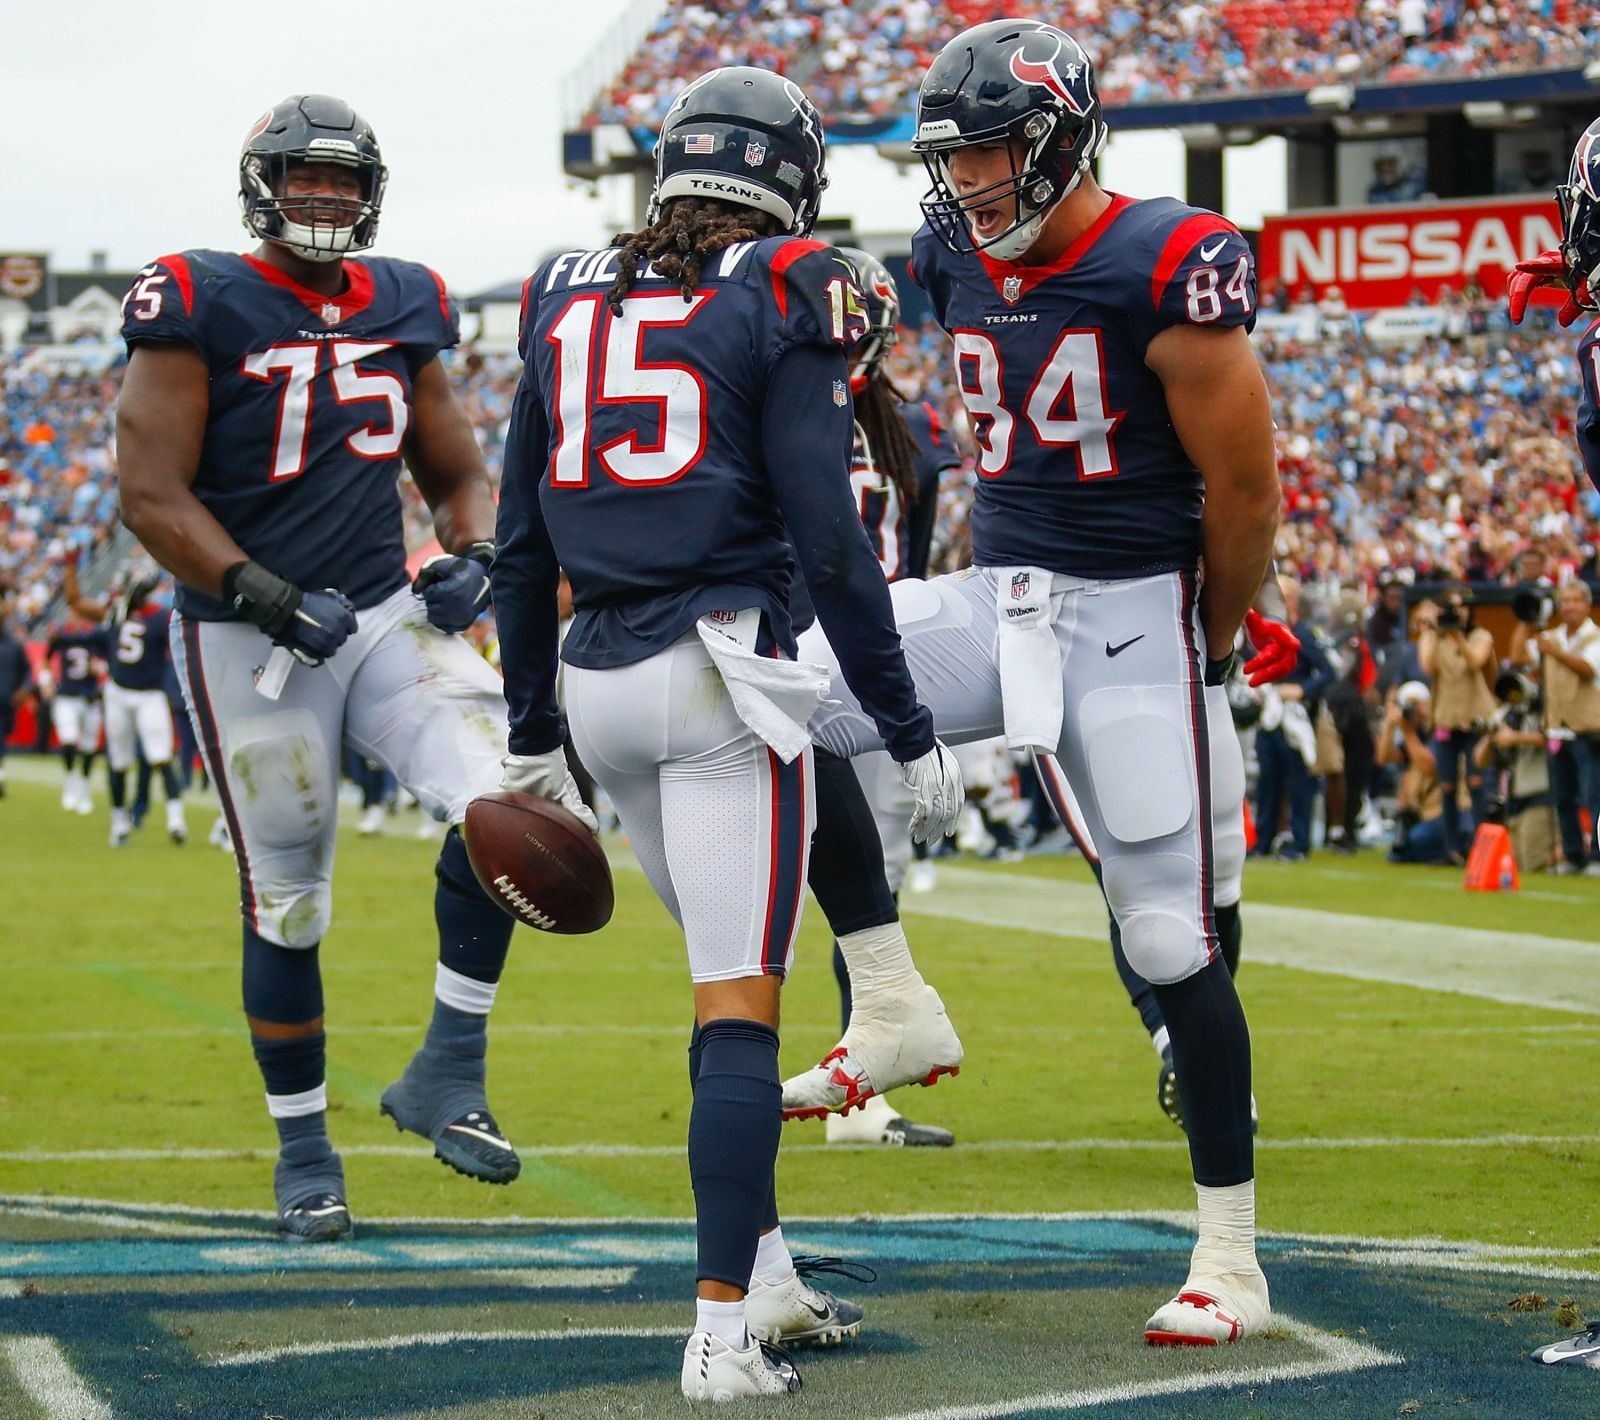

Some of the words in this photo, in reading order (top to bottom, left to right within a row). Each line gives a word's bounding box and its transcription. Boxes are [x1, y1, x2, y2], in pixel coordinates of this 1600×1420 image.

[922, 124, 948, 132] TEXANS
[747, 151, 763, 164] NFL
[690, 179, 763, 201] TEXANS
[718, 240, 757, 278] V
[1184, 252, 1251, 325] 84
[824, 277, 869, 343] 15
[984, 314, 1038, 325] TEXANS
[545, 289, 719, 489] 15
[952, 327, 1128, 483] 84
[239, 339, 408, 483] 75
[1006, 607, 1039, 618] Wilson
[117, 620, 146, 664] 5
